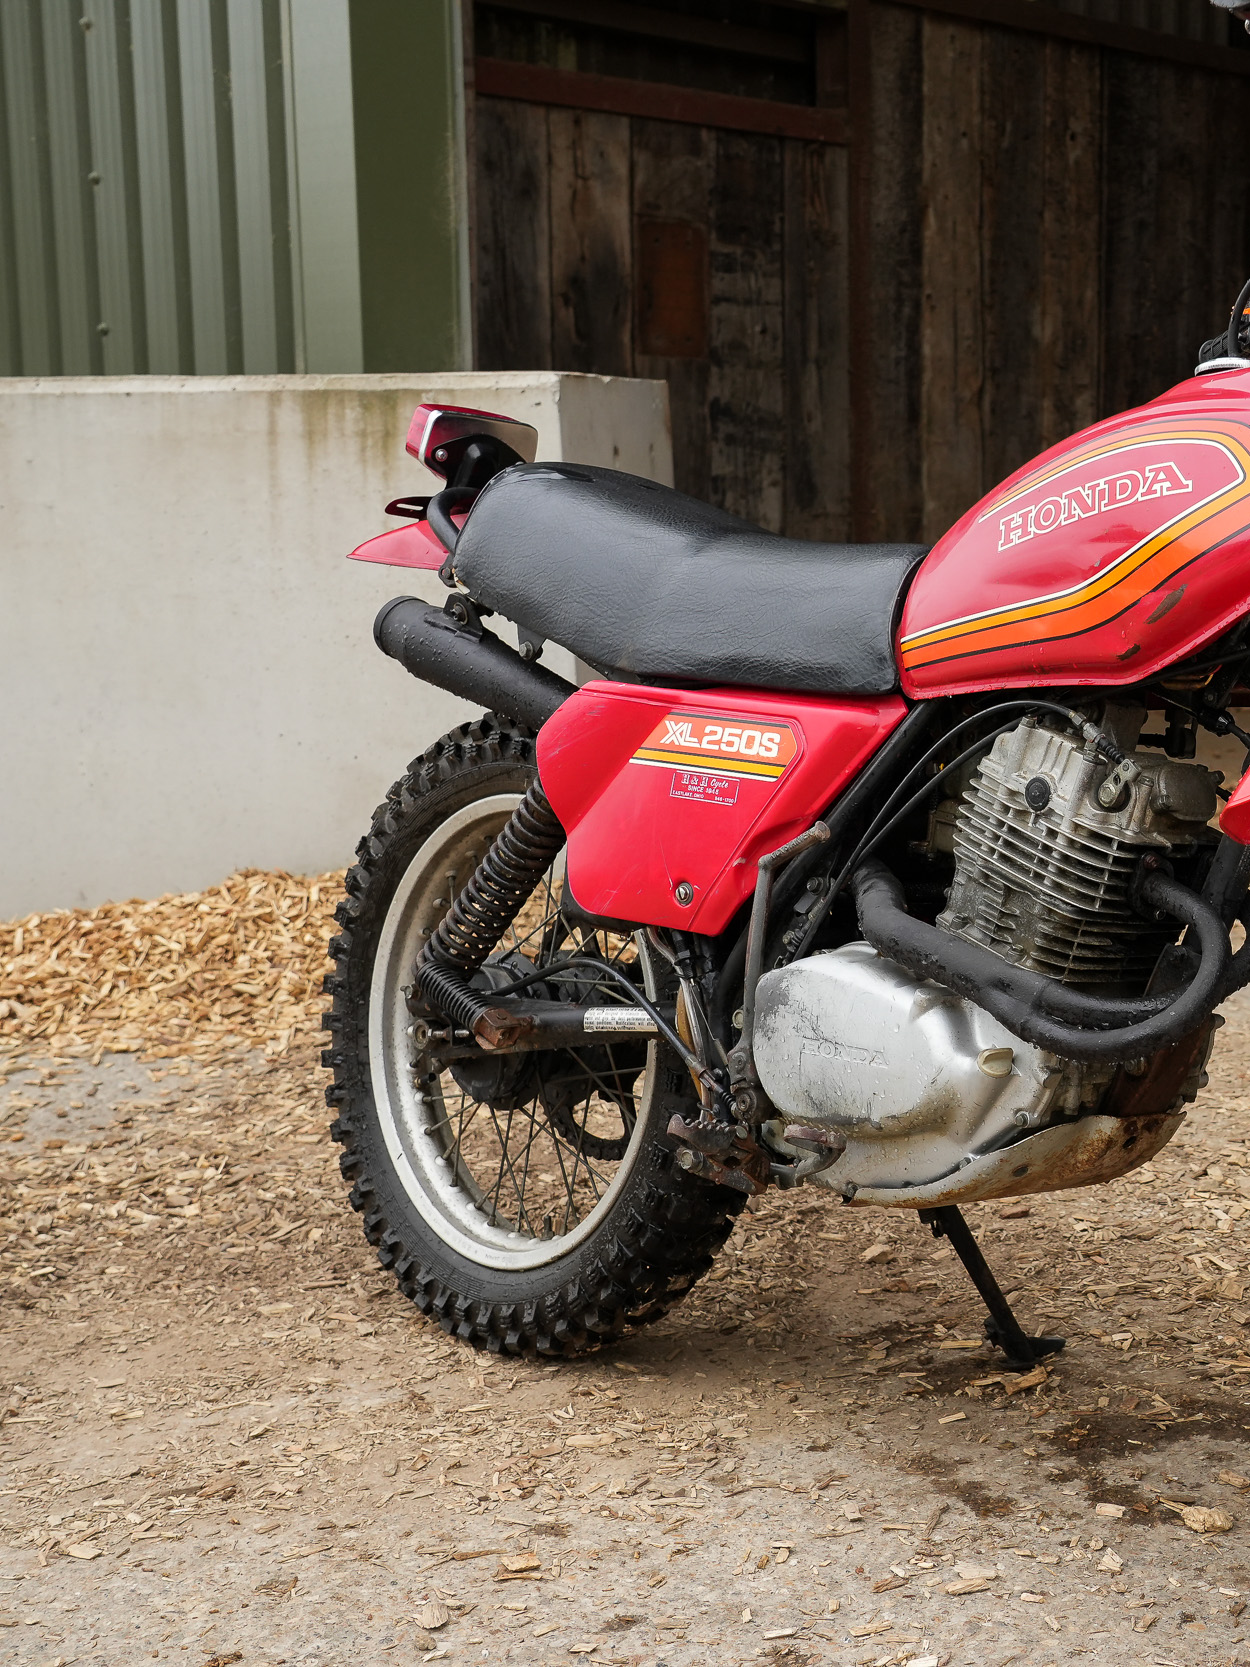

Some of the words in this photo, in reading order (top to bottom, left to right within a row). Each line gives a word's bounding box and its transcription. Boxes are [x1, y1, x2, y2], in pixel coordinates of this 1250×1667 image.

[998, 461, 1193, 552] HONDA
[687, 784, 705, 793] SINCE
[690, 775, 699, 785] &
[710, 778, 729, 789] Cycle
[801, 1038, 889, 1069] HONDA
